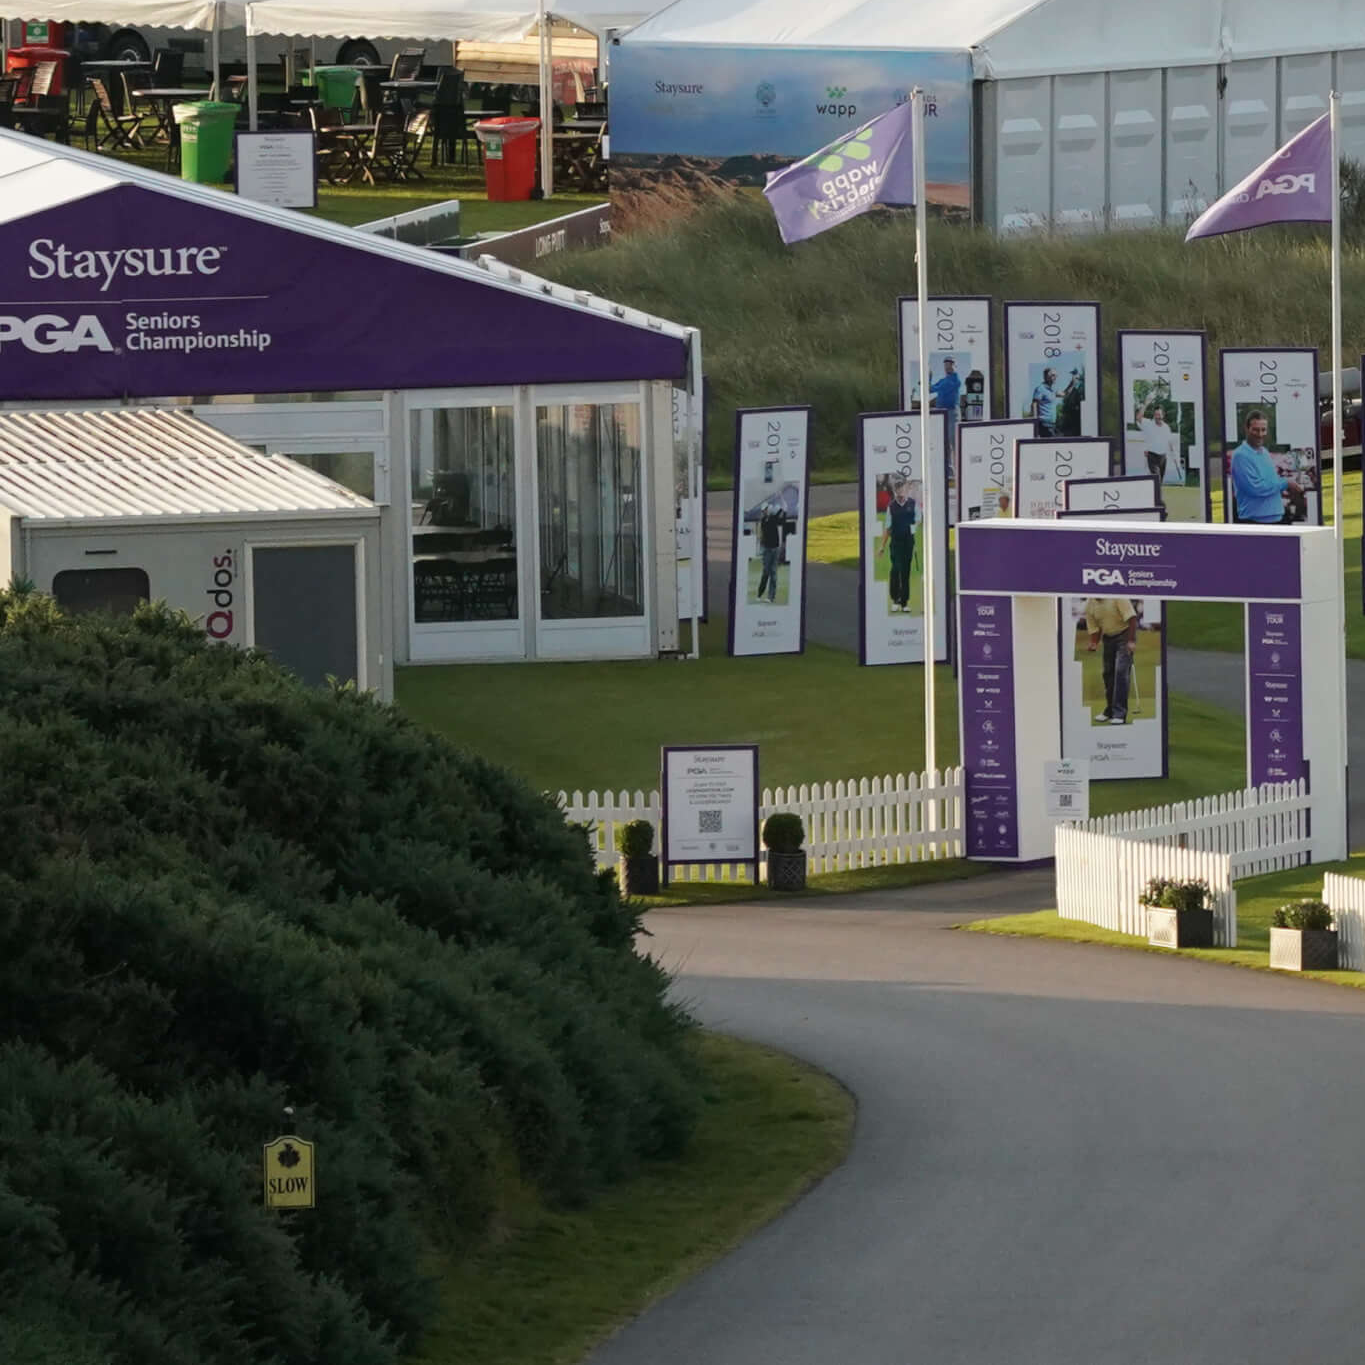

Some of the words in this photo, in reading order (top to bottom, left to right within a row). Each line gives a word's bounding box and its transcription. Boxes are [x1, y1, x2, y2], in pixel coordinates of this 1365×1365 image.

[655, 81, 704, 96] Staysure
[816, 102, 857, 117] wapp
[28, 238, 222, 292] Staysure
[126, 312, 201, 330] Seniors
[936, 307, 954, 351] 2021
[126, 329, 271, 353] Championship
[1043, 313, 1062, 358] 2018
[1259, 360, 1279, 405] 2012
[767, 420, 782, 467] 2011
[989, 434, 1005, 487] 2007
[1096, 538, 1160, 561] Staysure
[1082, 569, 1125, 586] PGA
[1128, 570, 1154, 579] Seniors
[1128, 578, 1178, 589] Championship
[268, 1177, 309, 1195] SLOW
